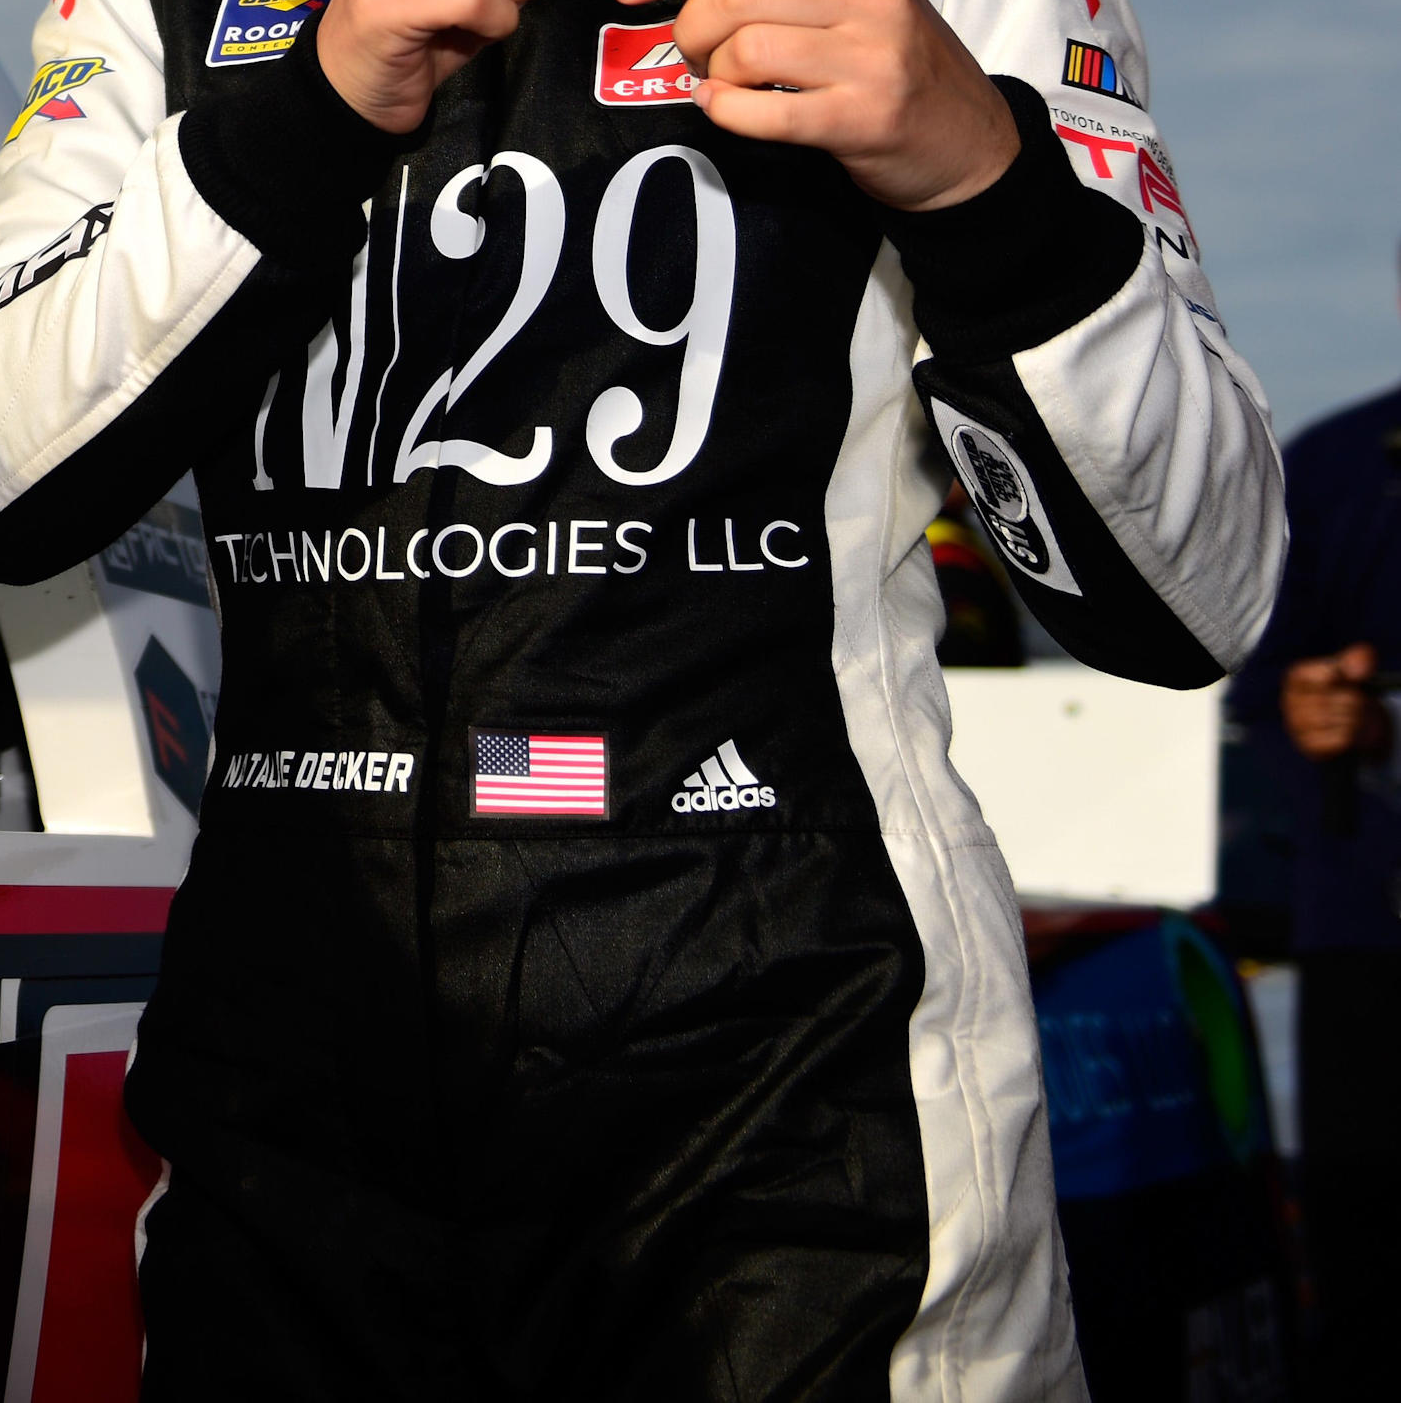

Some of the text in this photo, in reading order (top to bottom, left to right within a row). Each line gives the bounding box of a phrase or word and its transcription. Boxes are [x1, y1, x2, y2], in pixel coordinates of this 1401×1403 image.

[1051, 108, 1105, 134] TOYOTA
[687, 517, 809, 573] LLC
[295, 751, 415, 793] DECKER
[671, 782, 776, 813] adidas
